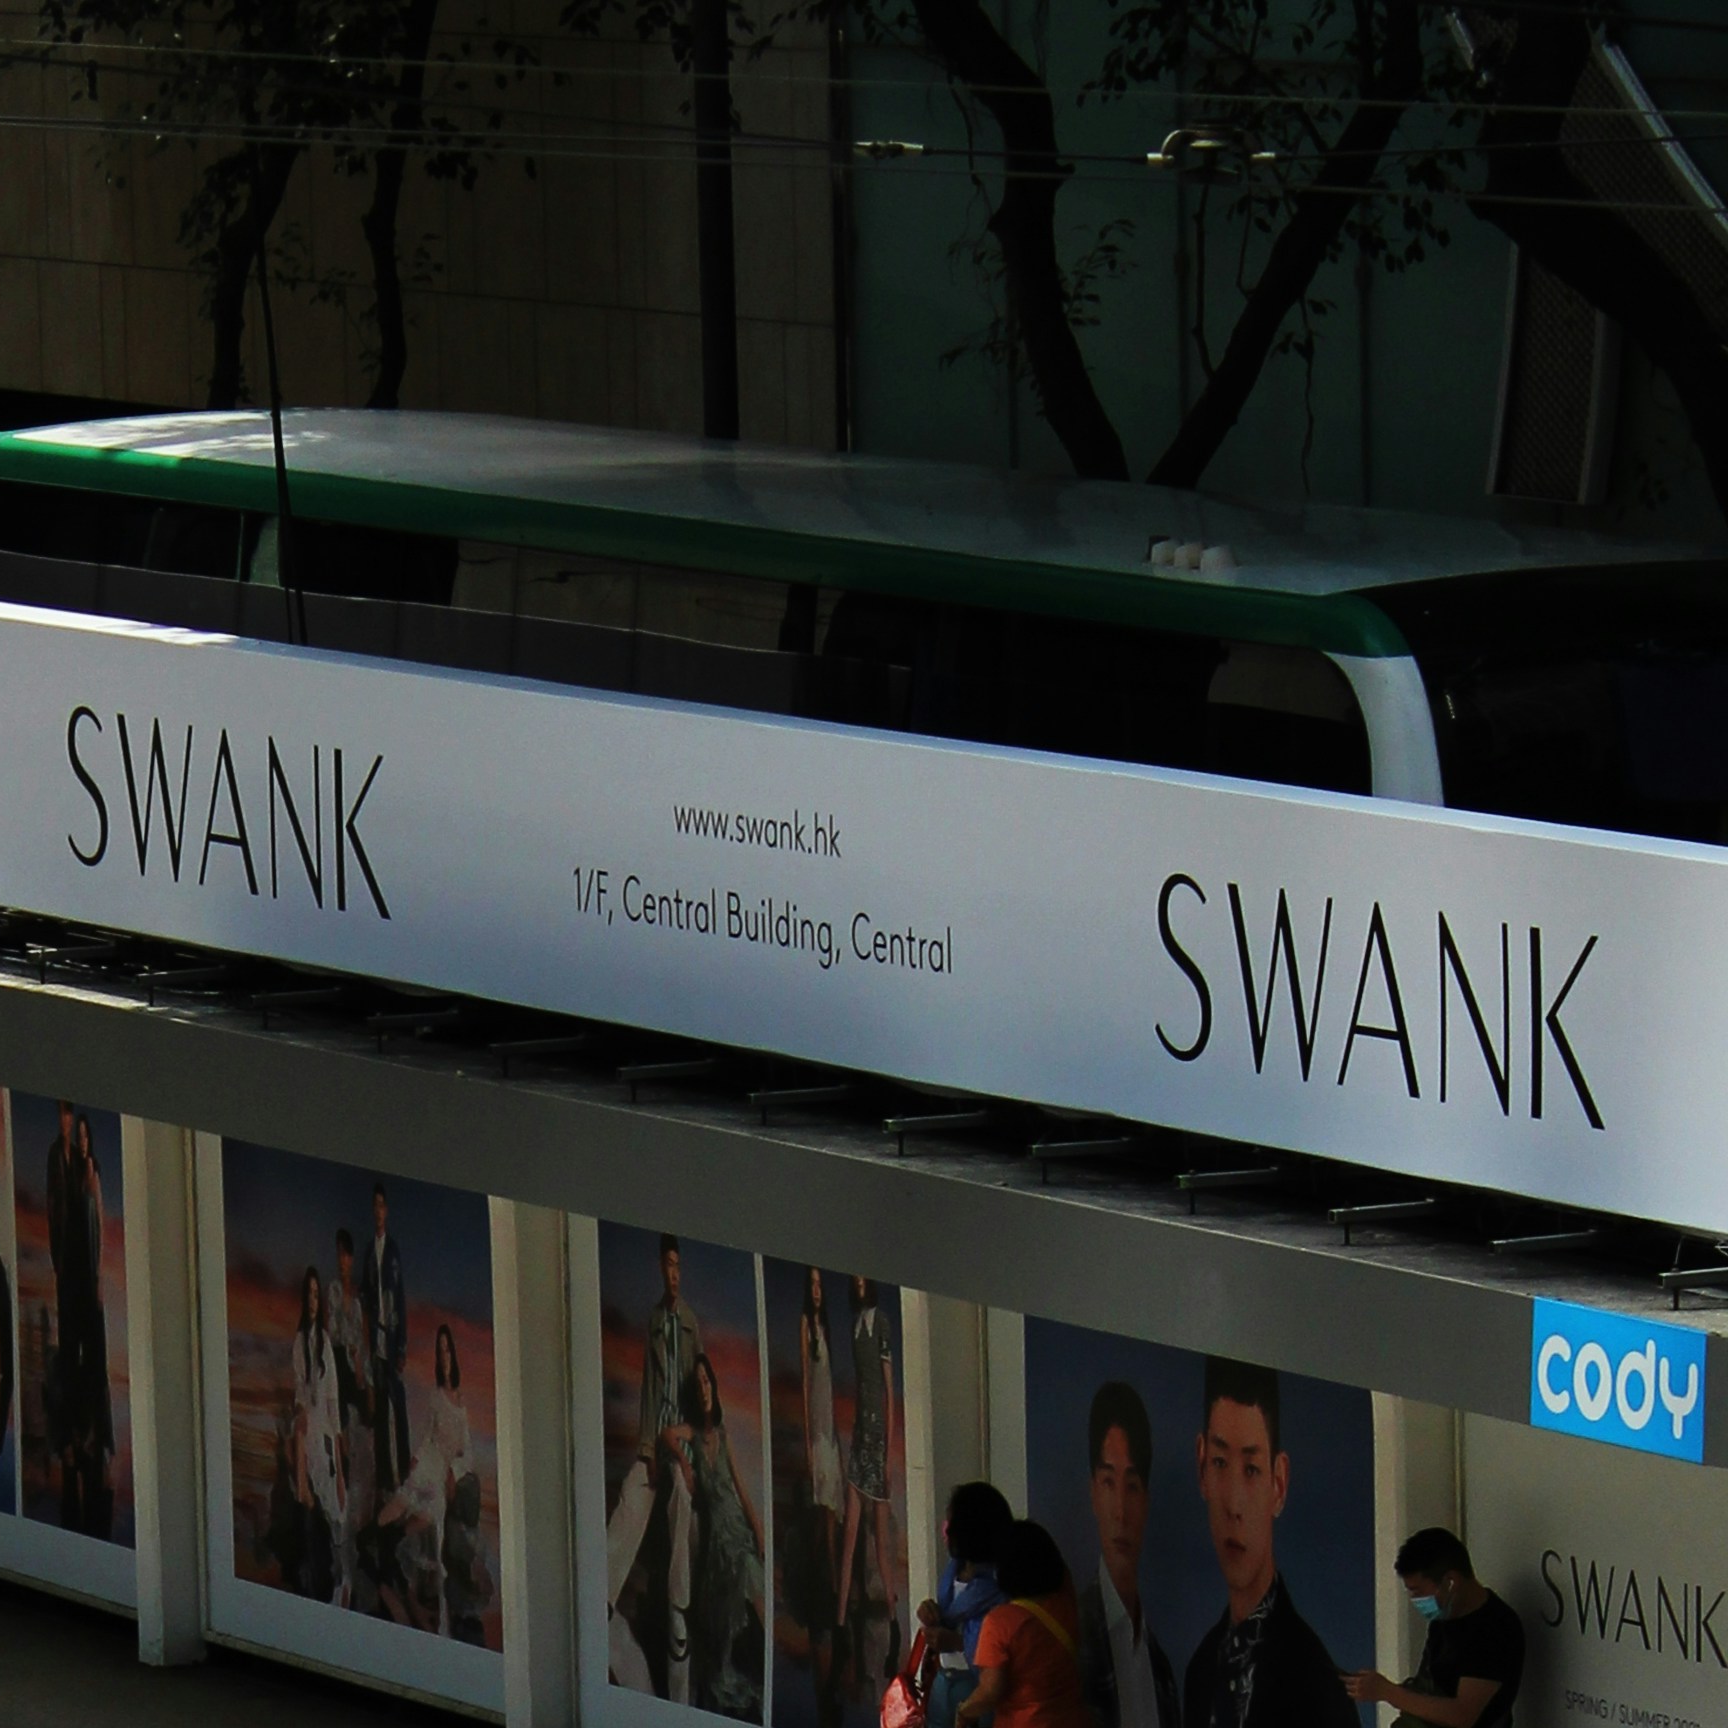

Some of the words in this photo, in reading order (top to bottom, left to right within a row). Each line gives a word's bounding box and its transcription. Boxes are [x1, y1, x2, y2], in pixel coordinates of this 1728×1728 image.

[67, 706, 391, 919] SWANK
[674, 801, 842, 859] www.swank.hk
[573, 867, 614, 924] 1/F,
[623, 877, 716, 933] Central
[727, 890, 842, 969] Building,
[851, 912, 953, 975] Central
[1156, 873, 1605, 1130] SWANK
[1537, 1332, 1701, 1439] cody
[1541, 1549, 1728, 1668] SWANK
[1565, 1689, 1608, 1720] SPRING
